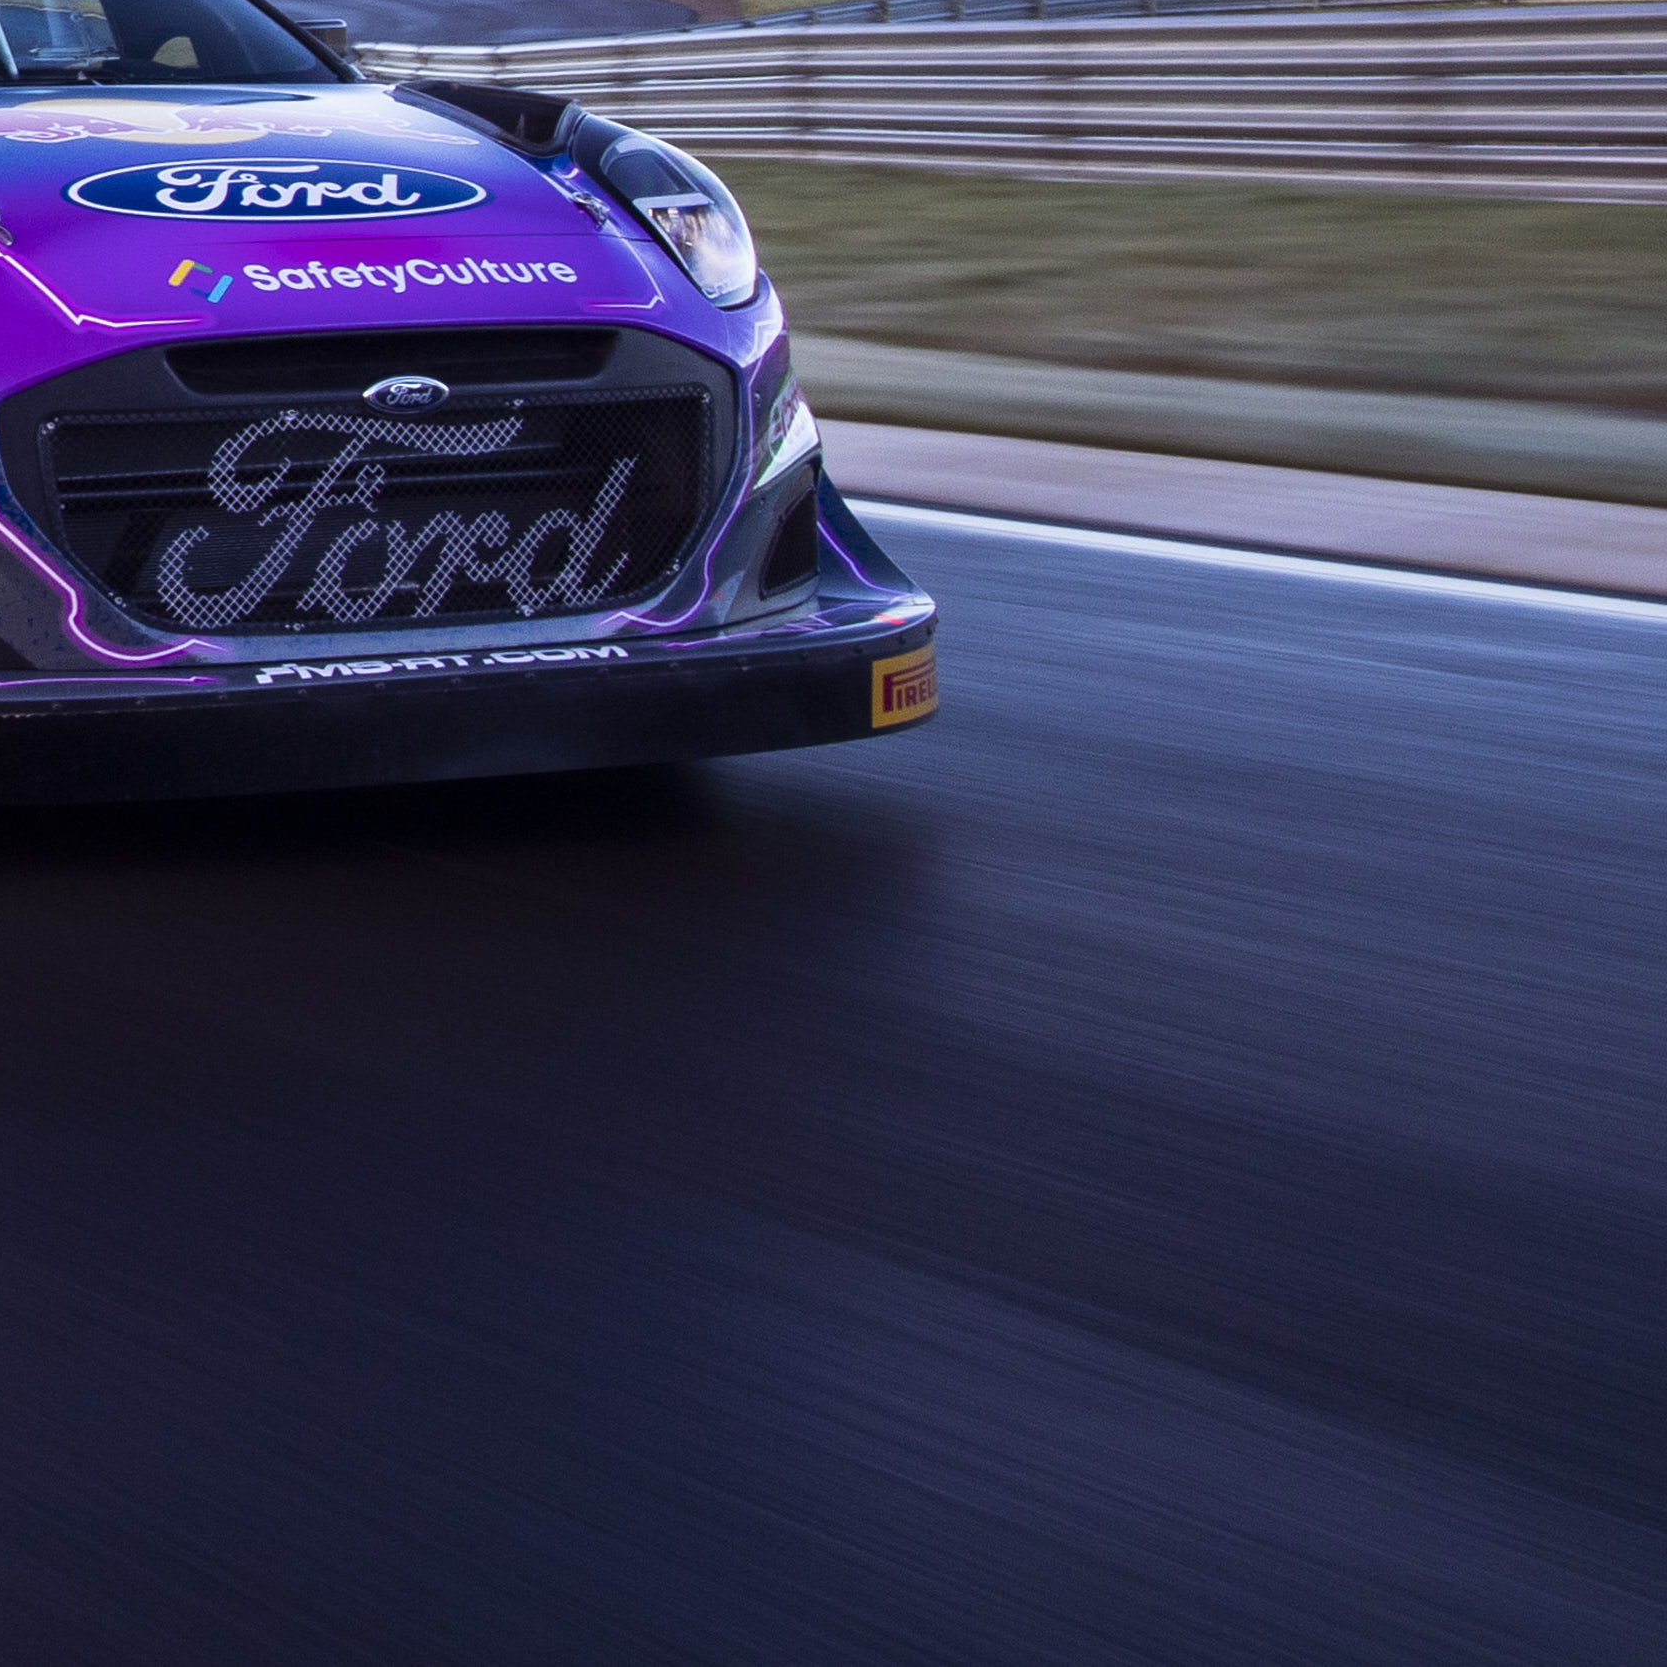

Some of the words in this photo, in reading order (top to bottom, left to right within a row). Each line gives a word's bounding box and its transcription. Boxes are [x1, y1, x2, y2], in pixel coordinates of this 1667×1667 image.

[155, 164, 421, 212] Ford
[243, 257, 578, 294] SafetyCulture
[386, 382, 434, 406] Ford
[158, 413, 639, 629] Ford
